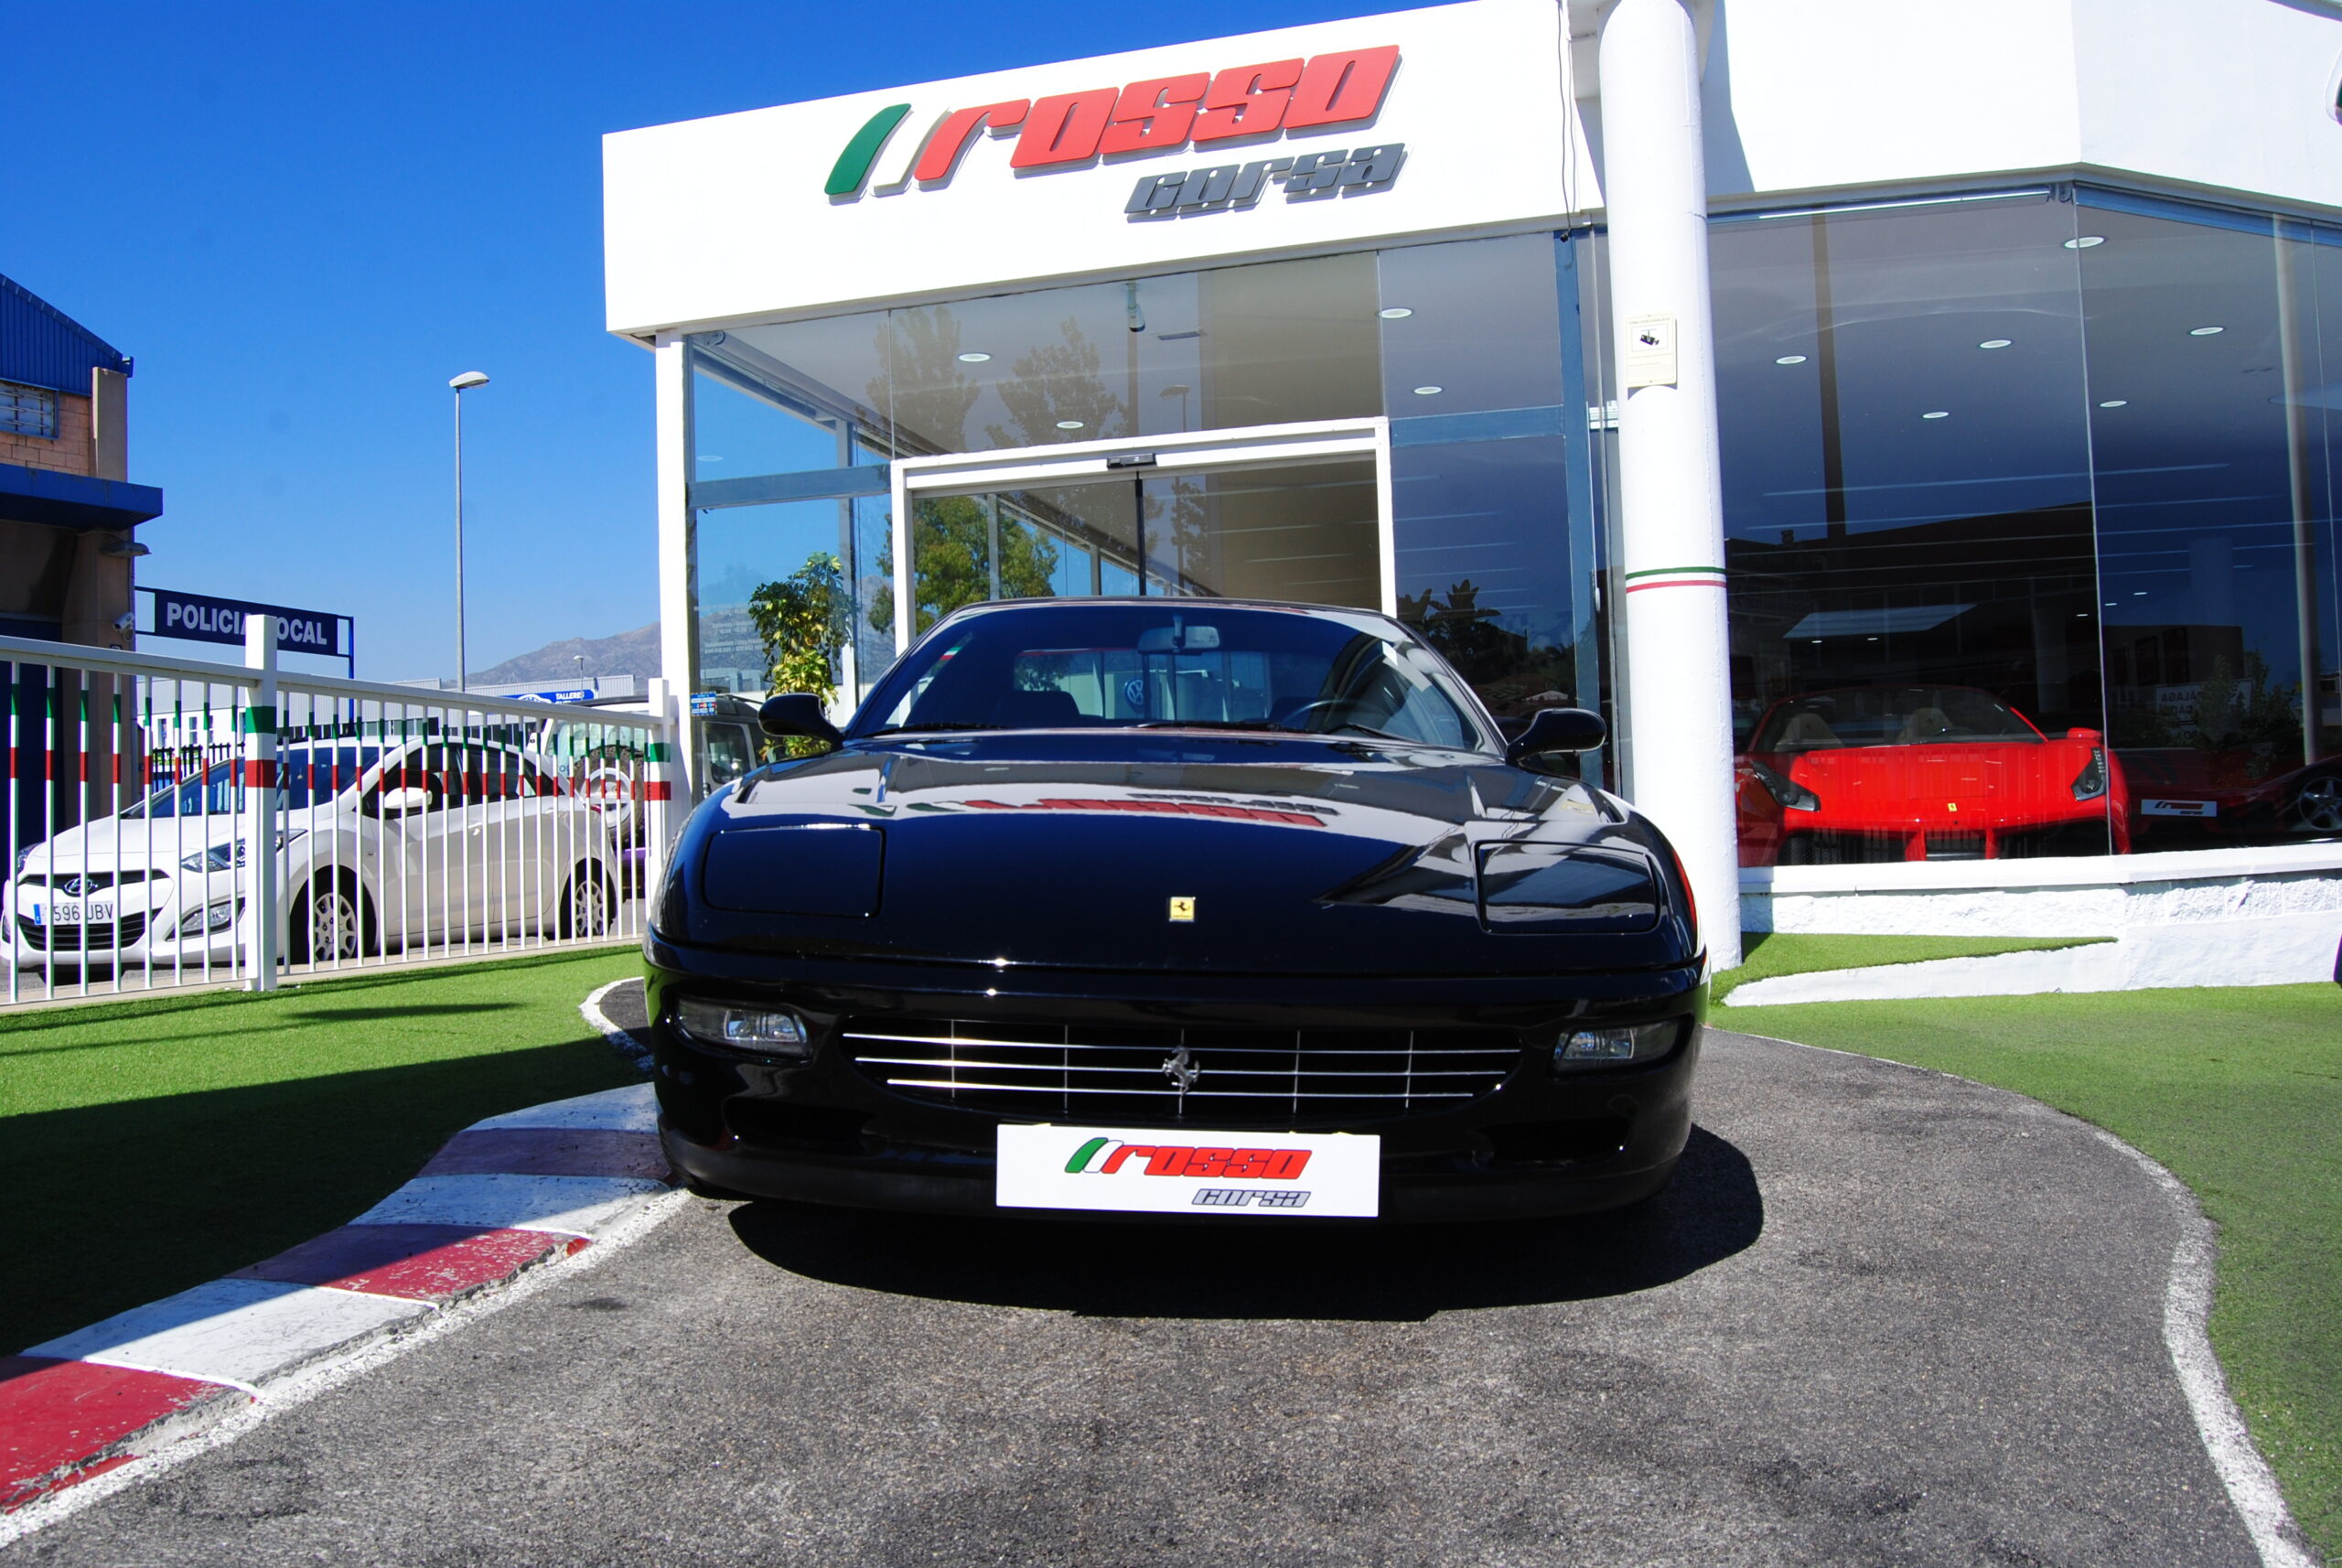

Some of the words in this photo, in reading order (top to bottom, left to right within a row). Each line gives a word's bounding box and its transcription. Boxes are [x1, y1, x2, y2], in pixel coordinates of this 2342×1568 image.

[915, 45, 1402, 187] rosso
[1123, 143, 1405, 220] corsa
[167, 601, 246, 635] POLICI
[276, 616, 328, 645] OCAL
[46, 905, 81, 921] 596
[1101, 1144, 1313, 1180] rosso
[1192, 1188, 1312, 1208] corsa
